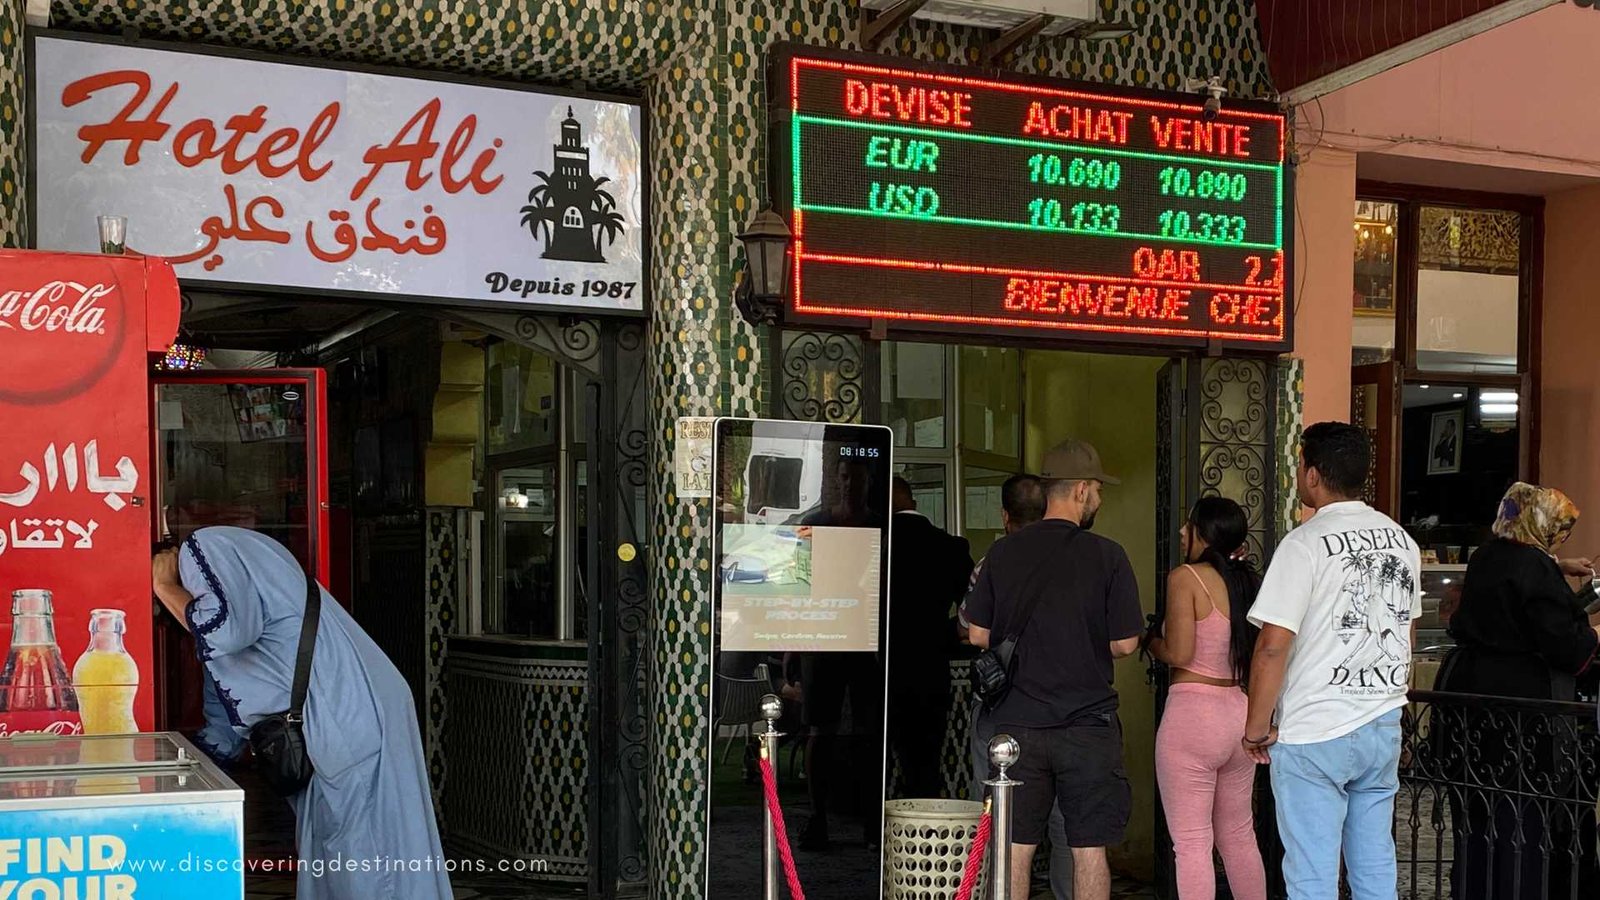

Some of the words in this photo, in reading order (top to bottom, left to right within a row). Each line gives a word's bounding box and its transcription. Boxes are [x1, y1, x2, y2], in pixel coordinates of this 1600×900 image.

[61, 70, 341, 182] Hotel
[350, 97, 504, 201] Ali
[846, 78, 972, 127] DEVISE
[1023, 101, 1133, 144] ACHAT
[1151, 115, 1250, 157] VENTE
[866, 135, 939, 173] EUR
[1028, 153, 1120, 190] 10.690
[1159, 166, 1247, 201] 10.890
[126, 184, 291, 271] علي
[306, 198, 447, 262] فندق
[869, 182, 939, 217] USD
[1028, 198, 1120, 233] 10.133
[1159, 210, 1247, 243] 10.333
[485, 272, 575, 298] Depuis
[581, 280, 637, 299] 1987
[1004, 277, 1191, 320] BIENVENUE
[1320, 527, 1410, 558] DESERT
[765, 610, 839, 621] PROCESS
[1328, 663, 1409, 688] DANC
[0, 835, 127, 876] FIND
